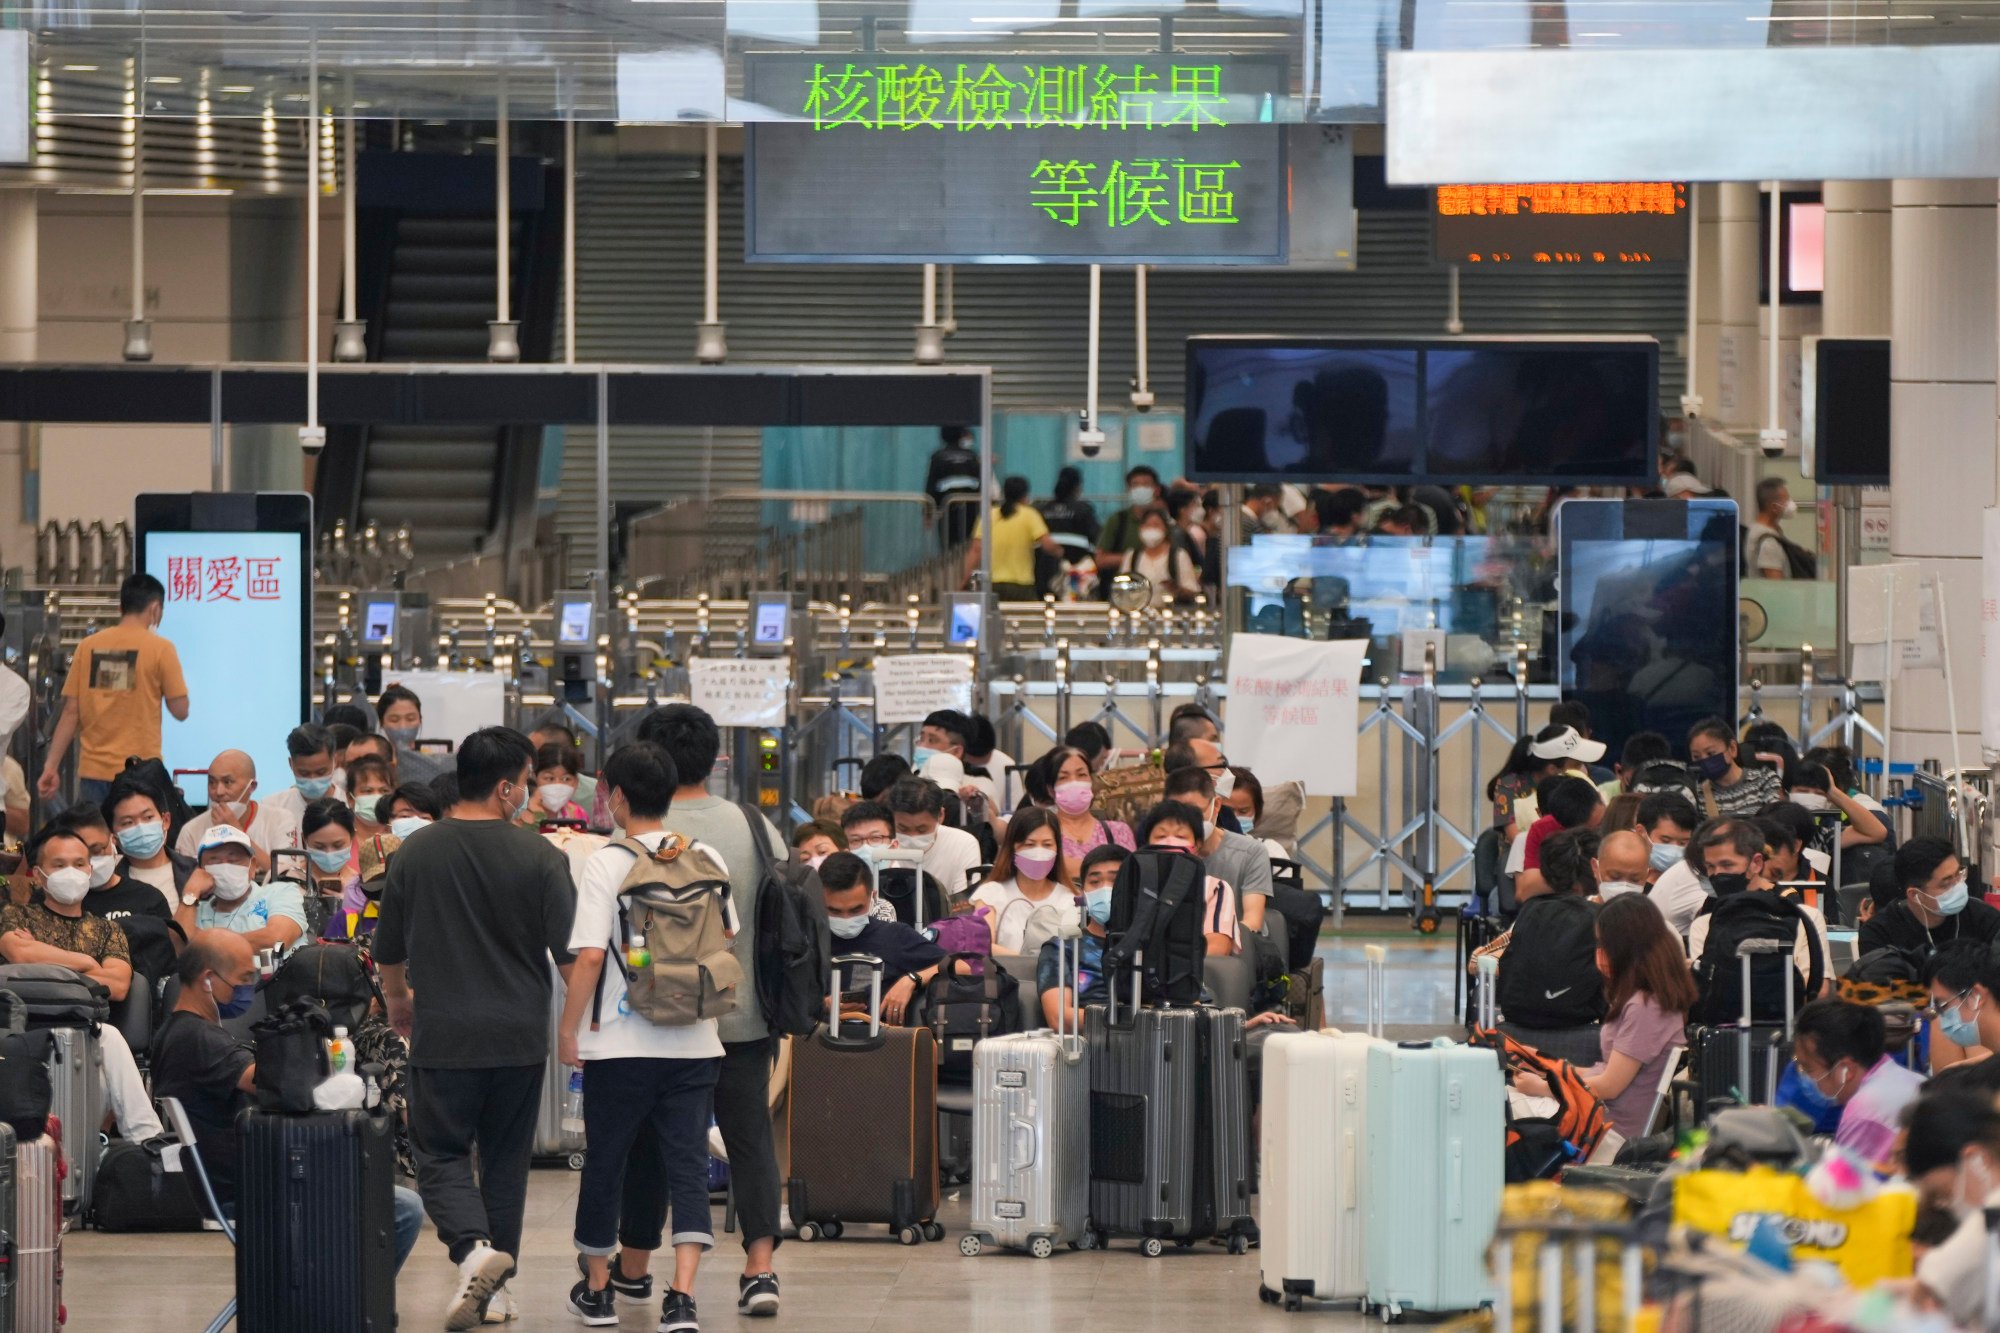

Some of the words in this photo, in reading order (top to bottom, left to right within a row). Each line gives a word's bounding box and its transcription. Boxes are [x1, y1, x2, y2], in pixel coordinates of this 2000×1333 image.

[803, 62, 1230, 132] 核酸檢測結果
[1029, 158, 1242, 228] 等候區
[167, 556, 282, 602] 關愛區
[1263, 704, 1319, 726] 等候區
